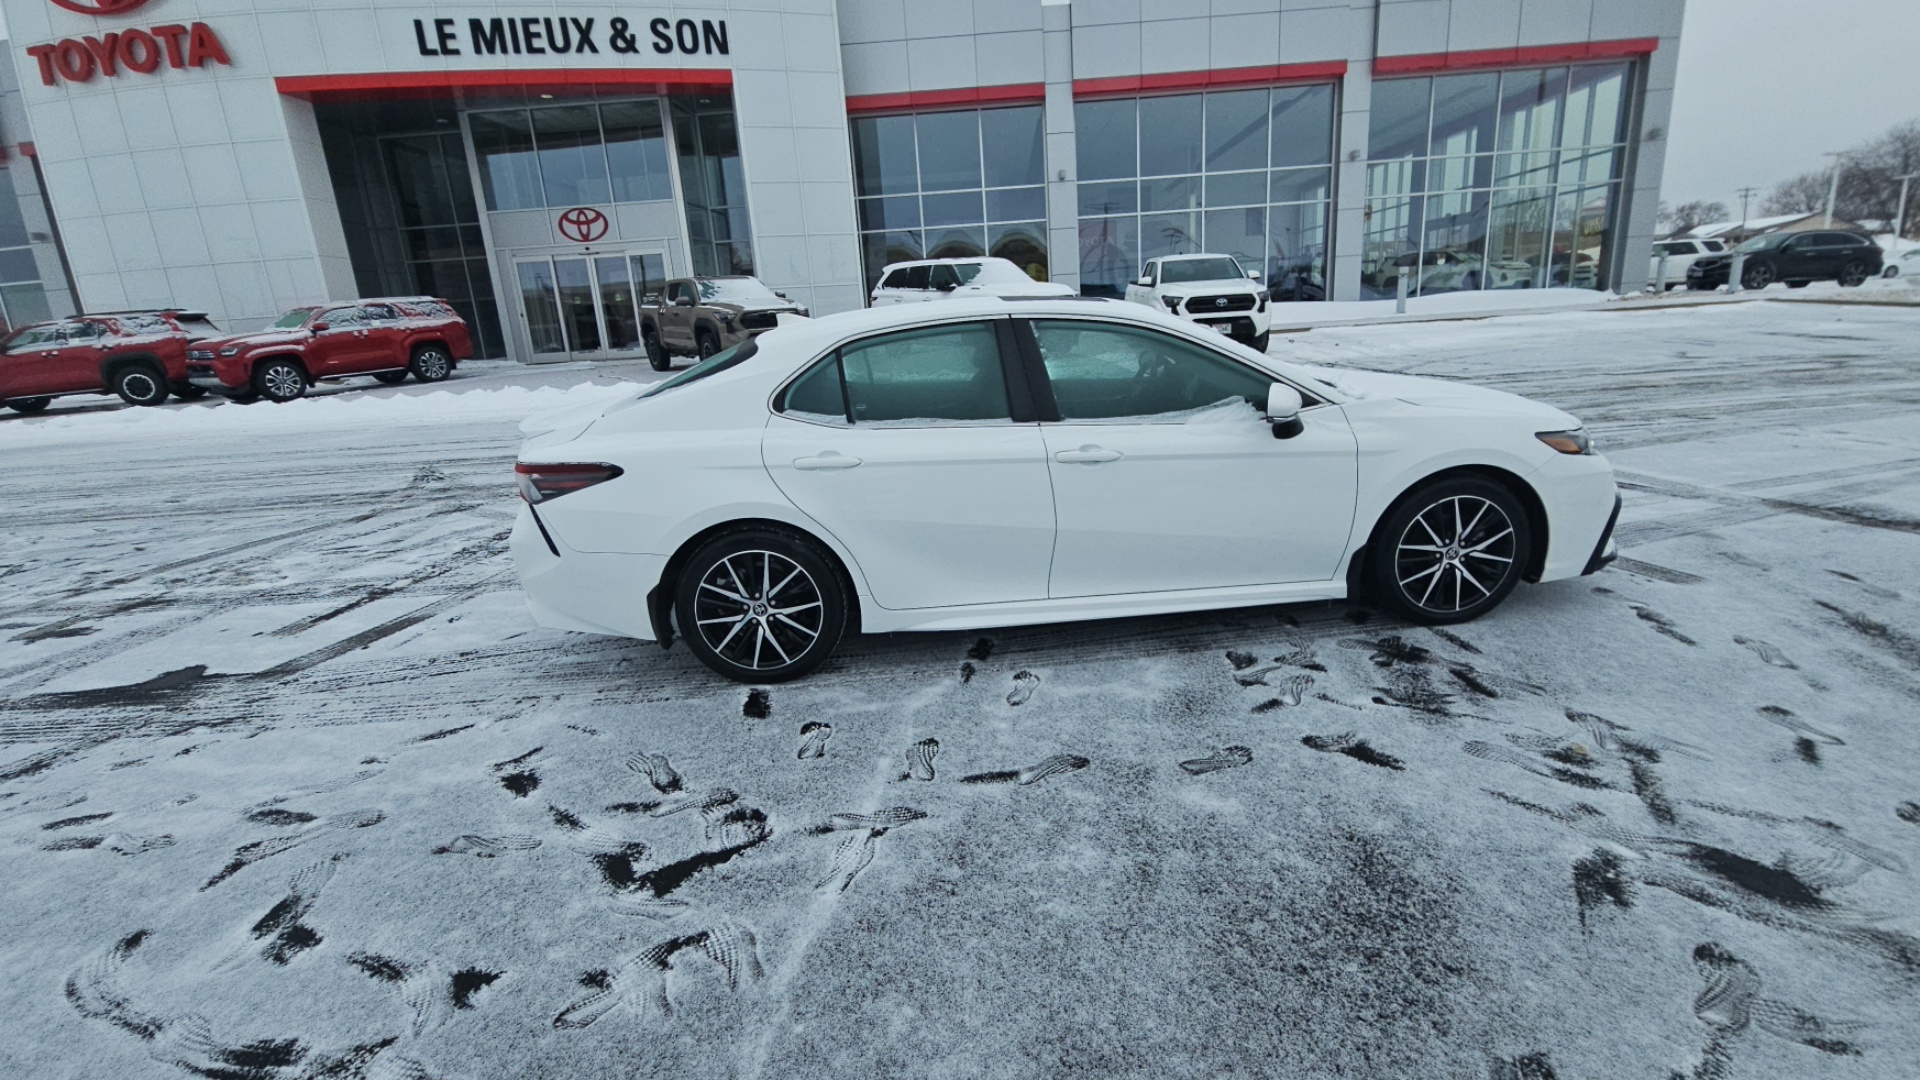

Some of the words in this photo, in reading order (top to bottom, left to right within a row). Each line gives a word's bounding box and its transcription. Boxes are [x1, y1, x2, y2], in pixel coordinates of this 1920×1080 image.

[26, 22, 231, 86] TOYOTA
[413, 19, 461, 56] LE
[468, 17, 599, 55] MIEUX
[609, 17, 640, 54] &
[649, 18, 730, 55] SON
